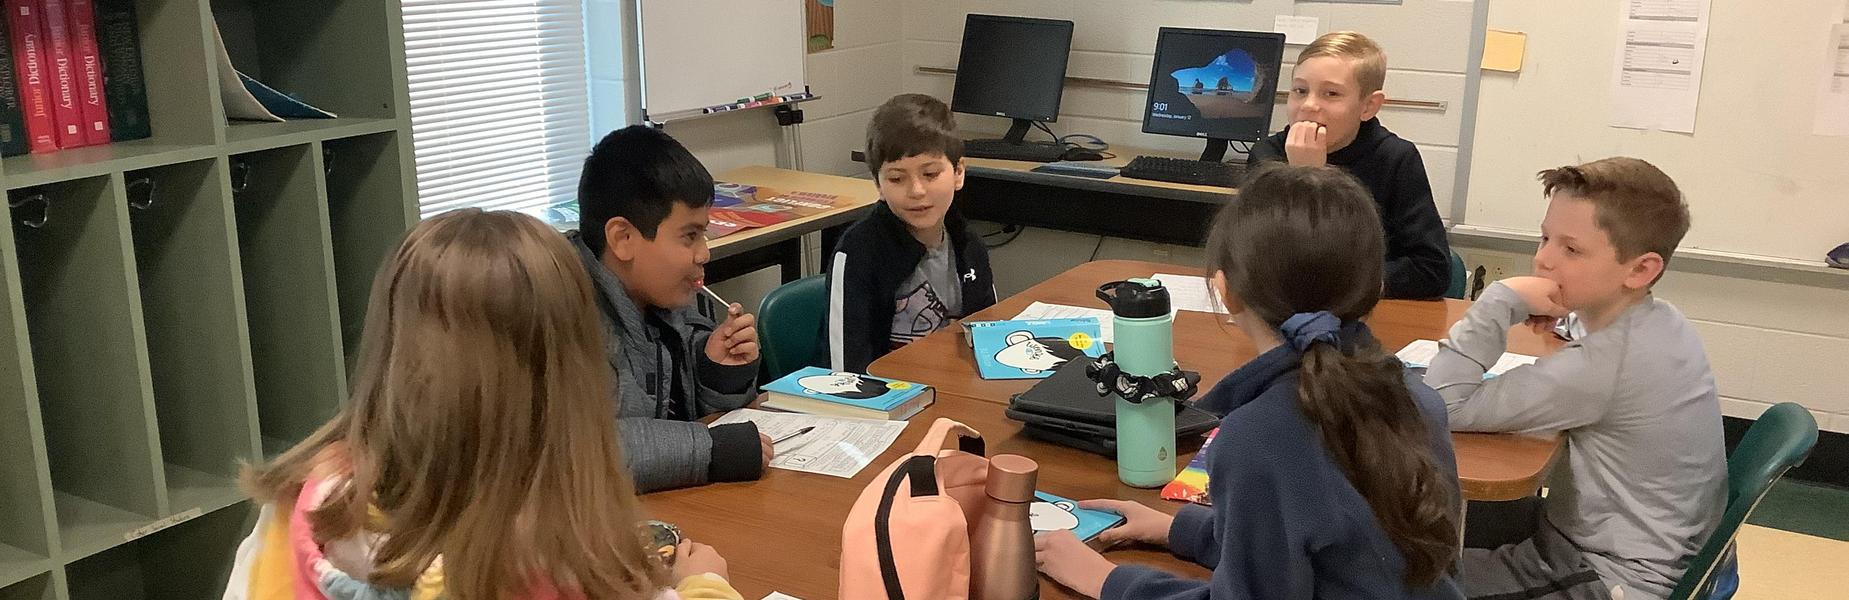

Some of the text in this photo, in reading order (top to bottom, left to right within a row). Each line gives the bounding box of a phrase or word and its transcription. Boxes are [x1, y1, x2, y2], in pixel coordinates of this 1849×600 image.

[24, 33, 48, 118] Junior Dictionary
[56, 57, 73, 109] Dictionary
[84, 55, 99, 106] Dictionary
[1153, 102, 1168, 111] 9:01
